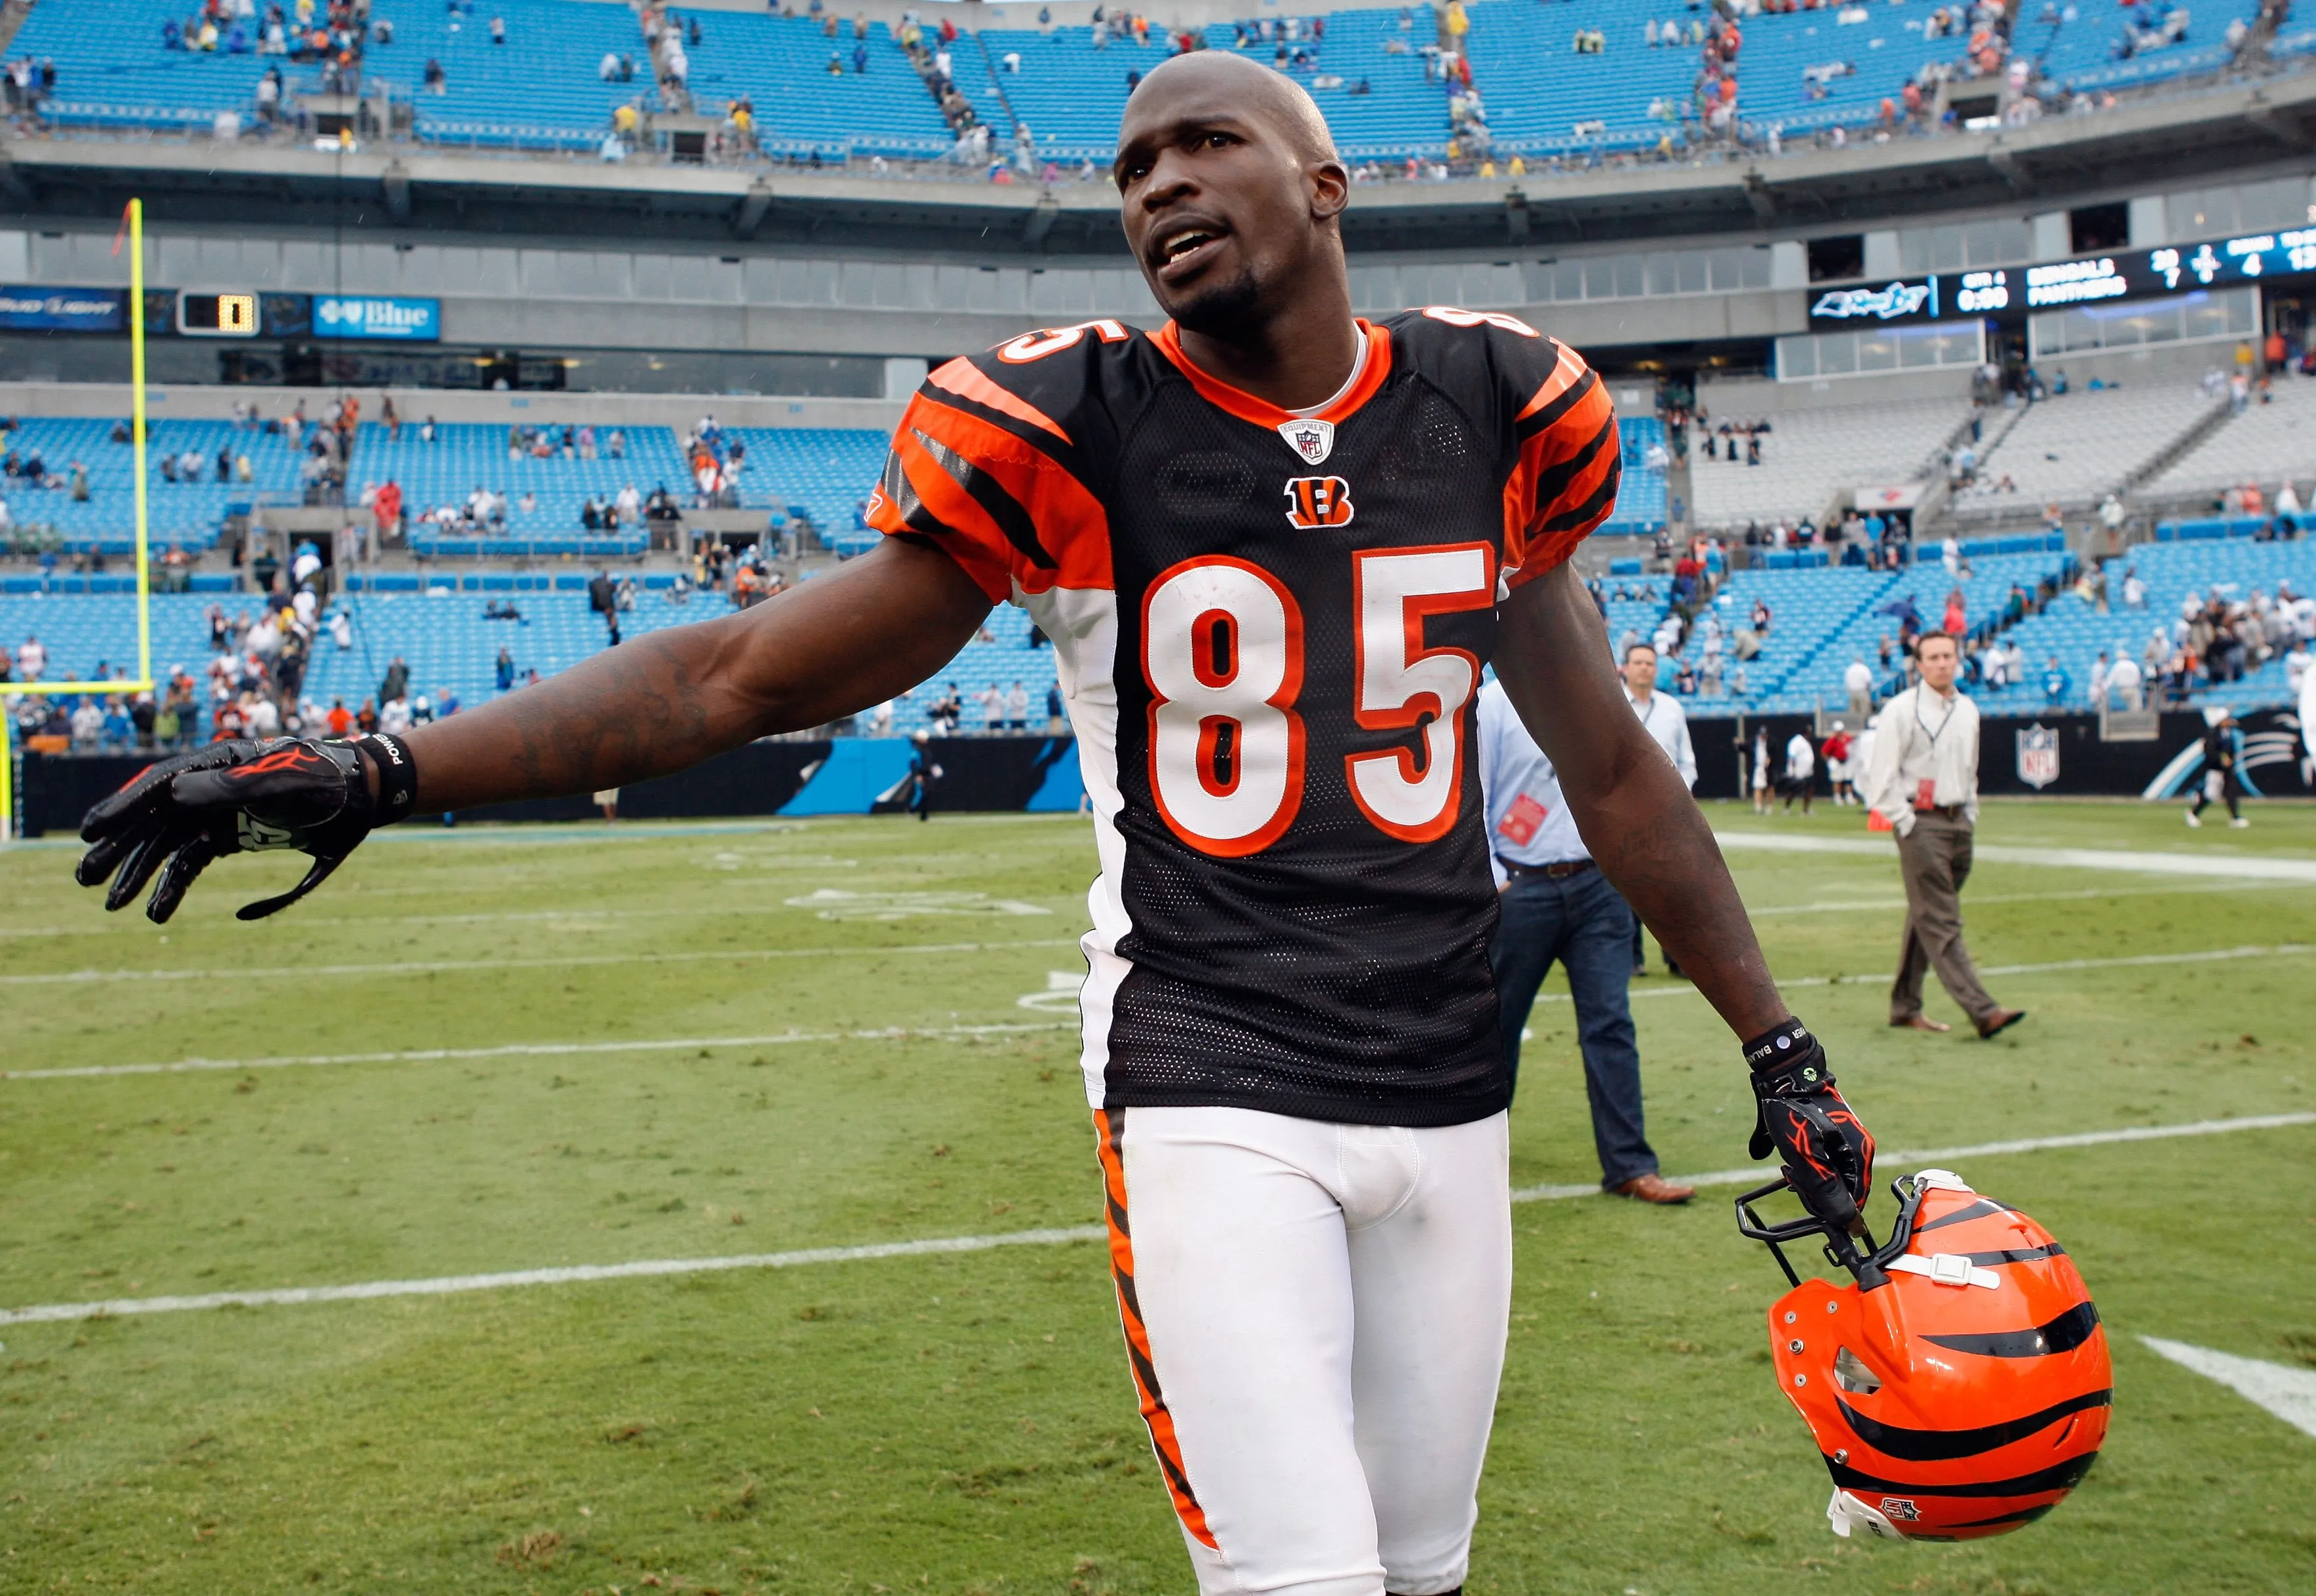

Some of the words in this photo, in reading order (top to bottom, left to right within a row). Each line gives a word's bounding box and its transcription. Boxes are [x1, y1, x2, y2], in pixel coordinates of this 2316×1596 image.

[2028, 257, 2115, 286] BENGALS
[2242, 253, 2262, 276] 4
[1958, 286, 2009, 311] 0:00
[2028, 275, 2127, 306] PANTHERS
[364, 301, 429, 326] Blue
[1283, 422, 1328, 434] EQUIPMENT
[1300, 441, 1321, 455] NFL
[1140, 539, 1496, 858] 85
[372, 733, 404, 765] POWE
[1886, 1501, 1904, 1517] NFL
